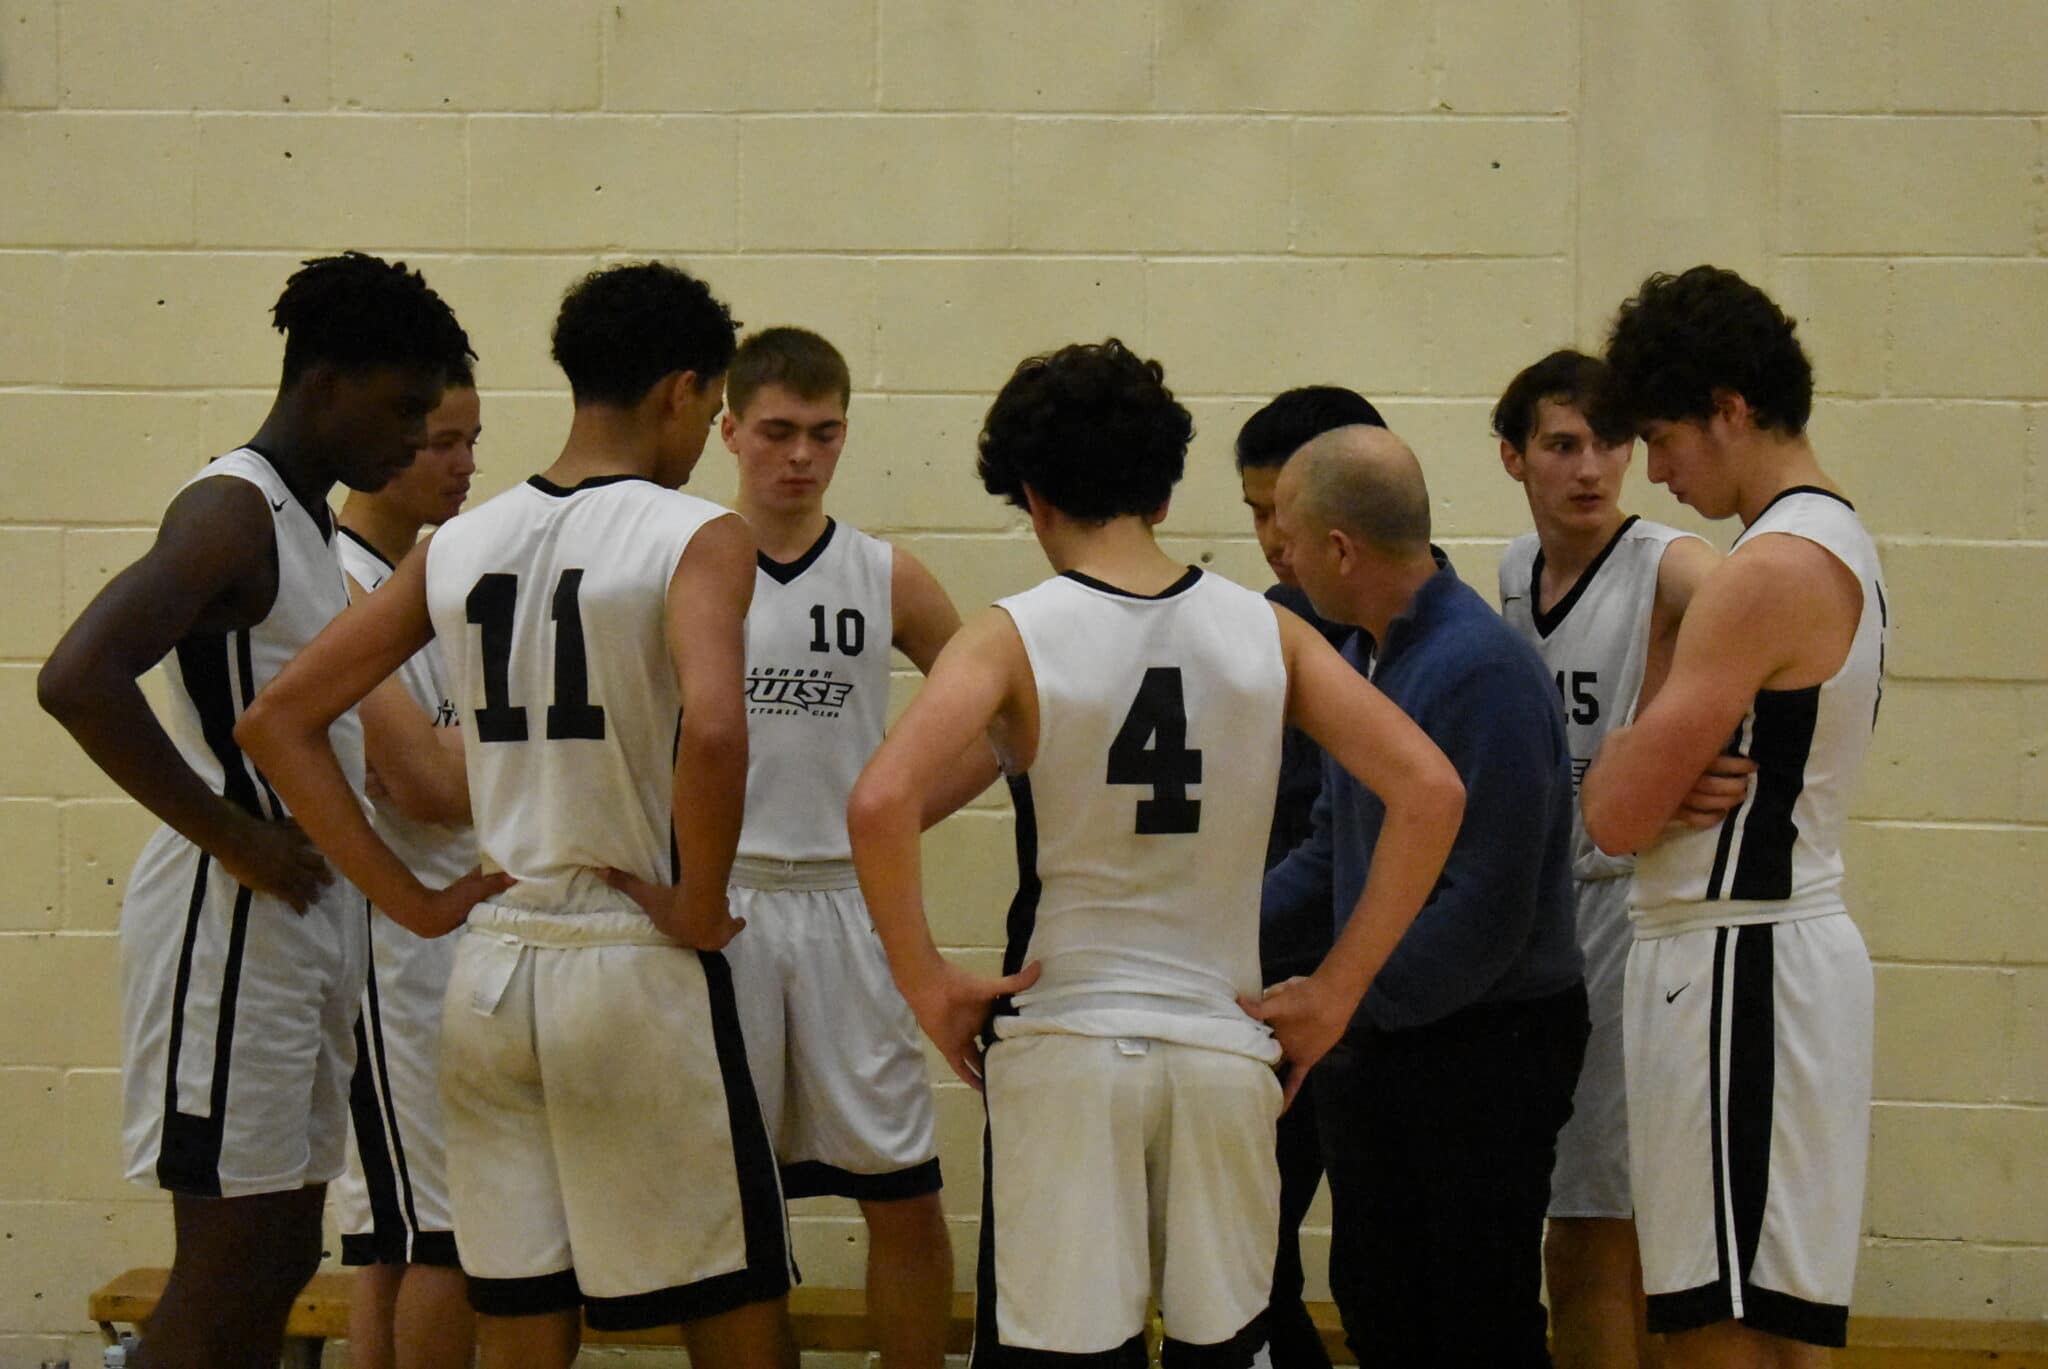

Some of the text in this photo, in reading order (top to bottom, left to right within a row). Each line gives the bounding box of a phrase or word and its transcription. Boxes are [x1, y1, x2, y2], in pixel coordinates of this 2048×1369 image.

[465, 568, 606, 742] 11
[810, 604, 865, 657] 10
[751, 667, 833, 679] LONDON
[746, 707, 800, 716] ETBALL
[1106, 666, 1203, 834] 4
